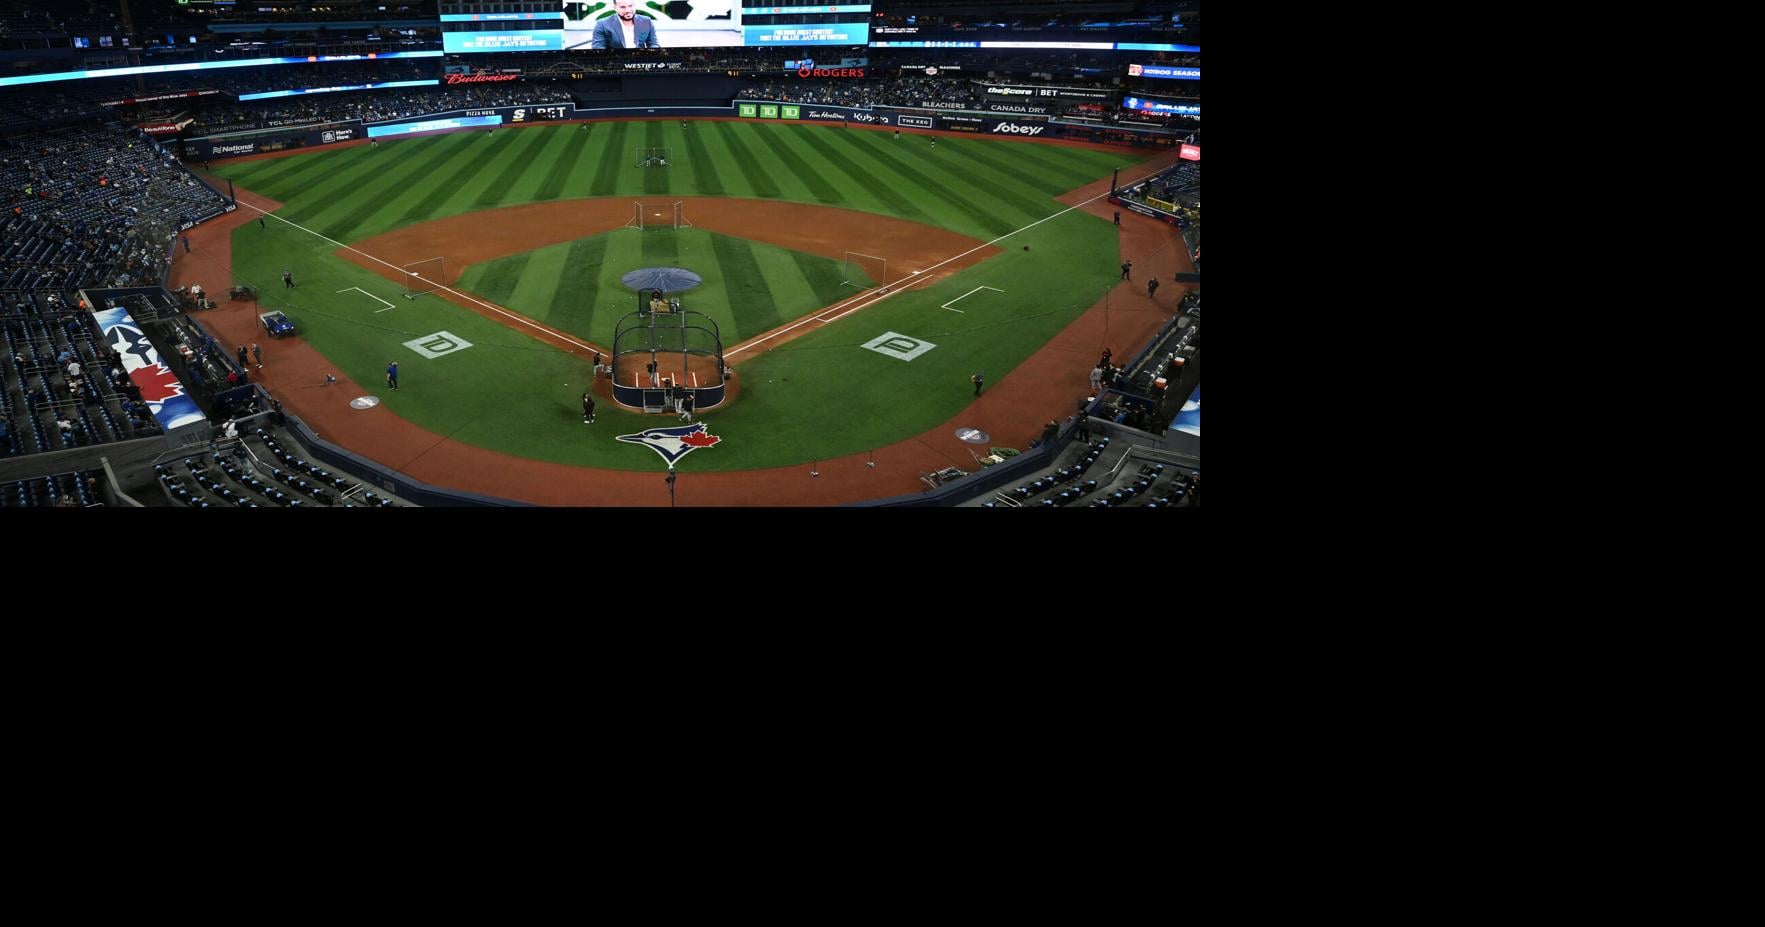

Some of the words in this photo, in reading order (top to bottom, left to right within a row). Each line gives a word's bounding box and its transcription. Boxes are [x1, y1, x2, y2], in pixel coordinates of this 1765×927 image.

[624, 62, 657, 70] WESTJET
[813, 68, 865, 77] ROGERS
[444, 73, 517, 85] Budweiser
[987, 87, 1033, 96] theScore
[1040, 89, 1058, 97] BET
[922, 101, 966, 109] BLEACHERS
[991, 104, 1027, 113] CANADA
[1028, 106, 1046, 114] DRY
[740, 106, 755, 115] TD
[761, 107, 776, 116] TD
[783, 107, 798, 117] TD
[821, 111, 845, 120] Hortons
[209, 124, 256, 133] SMARTPHONE
[993, 121, 1044, 135] Sobeys
[222, 143, 254, 153] National
